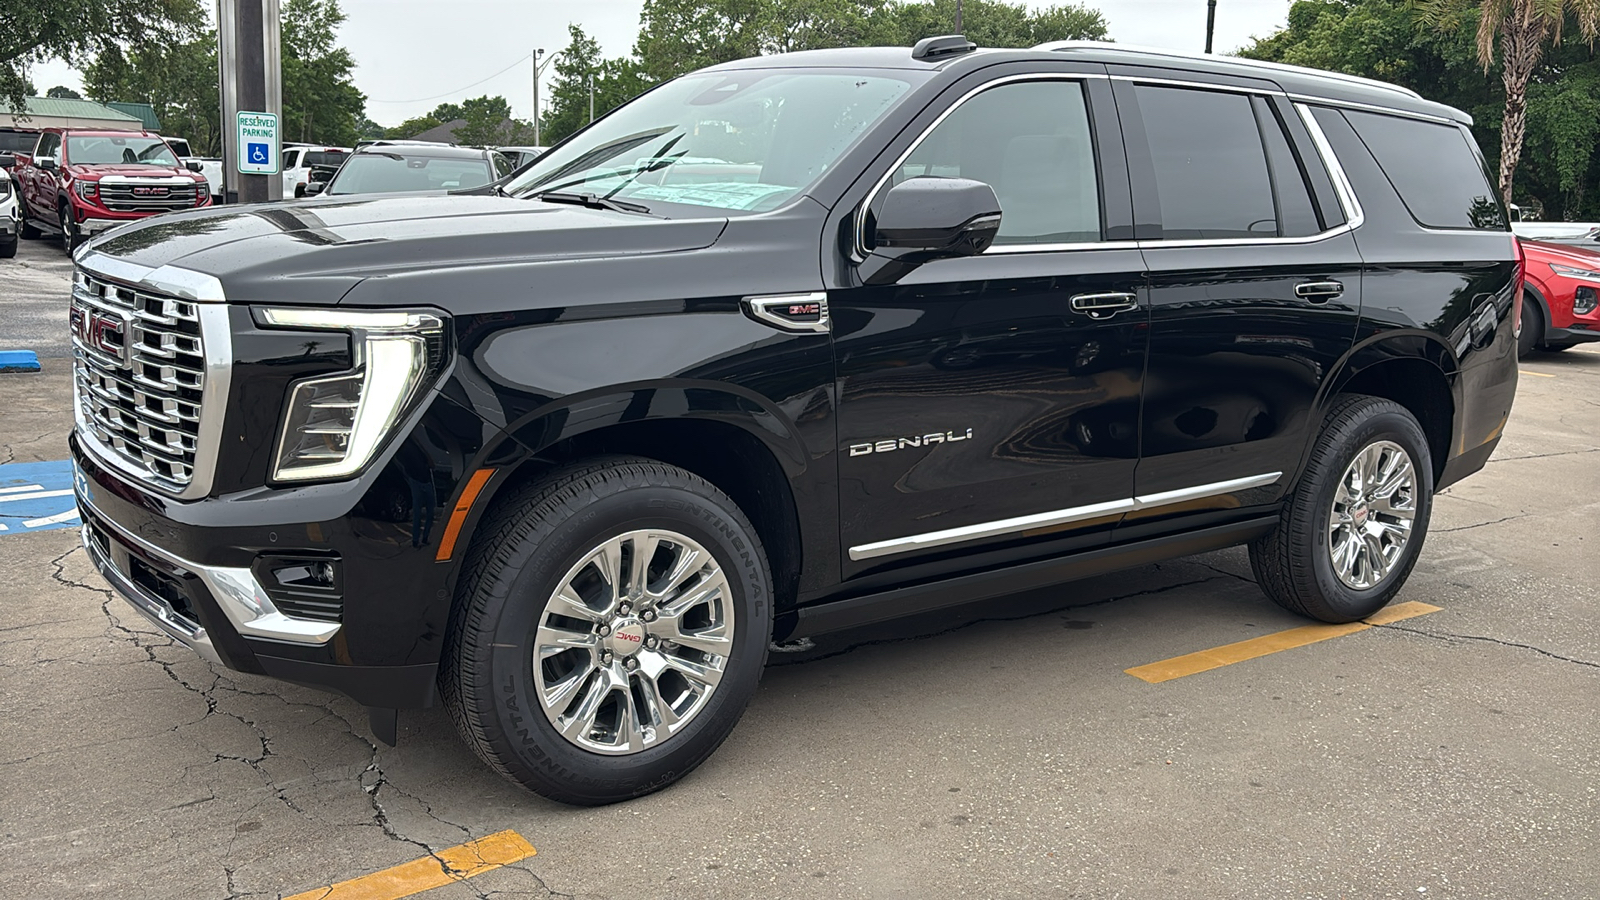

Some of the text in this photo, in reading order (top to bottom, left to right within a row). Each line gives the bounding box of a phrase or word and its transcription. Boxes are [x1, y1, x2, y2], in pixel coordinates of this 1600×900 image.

[240, 117, 275, 128] RESERVED
[242, 128, 273, 138] PARKING
[133, 187, 168, 195] GMC
[789, 304, 819, 314] GMC
[70, 305, 122, 359] GMC
[849, 428, 973, 457] DENALI
[647, 498, 764, 618] CONTINENTAL
[615, 631, 641, 643] GMC
